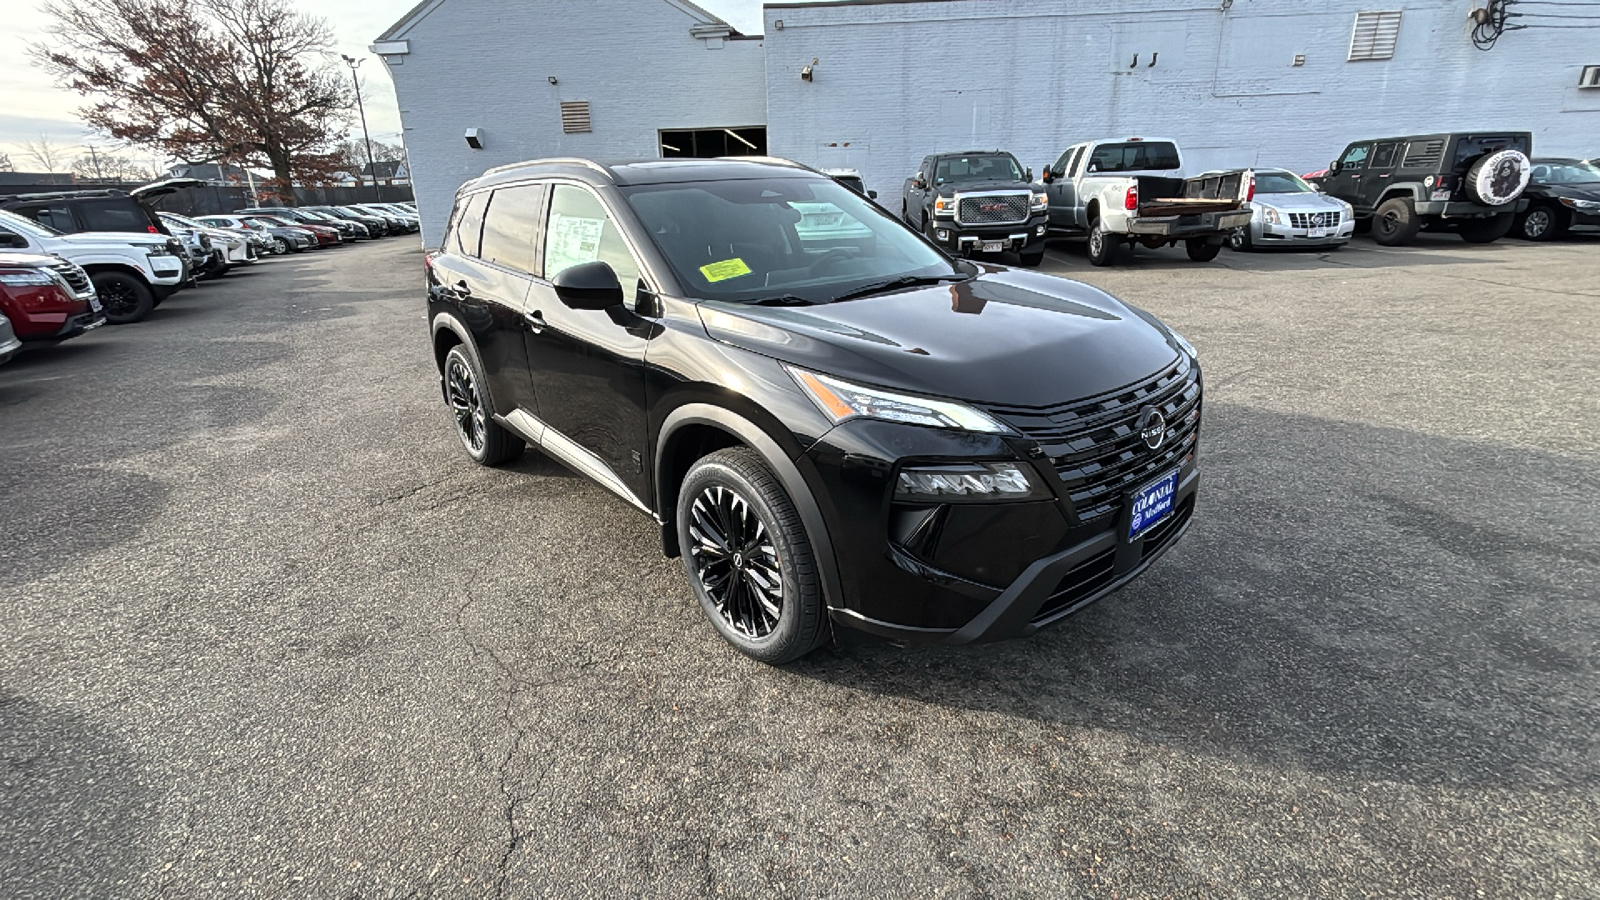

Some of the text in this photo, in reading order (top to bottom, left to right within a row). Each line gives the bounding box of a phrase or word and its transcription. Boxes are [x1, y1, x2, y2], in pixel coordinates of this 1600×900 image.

[1141, 424, 1164, 439] NISS
[1132, 481, 1174, 516] COLONIAL
[1144, 496, 1171, 520] Medford
